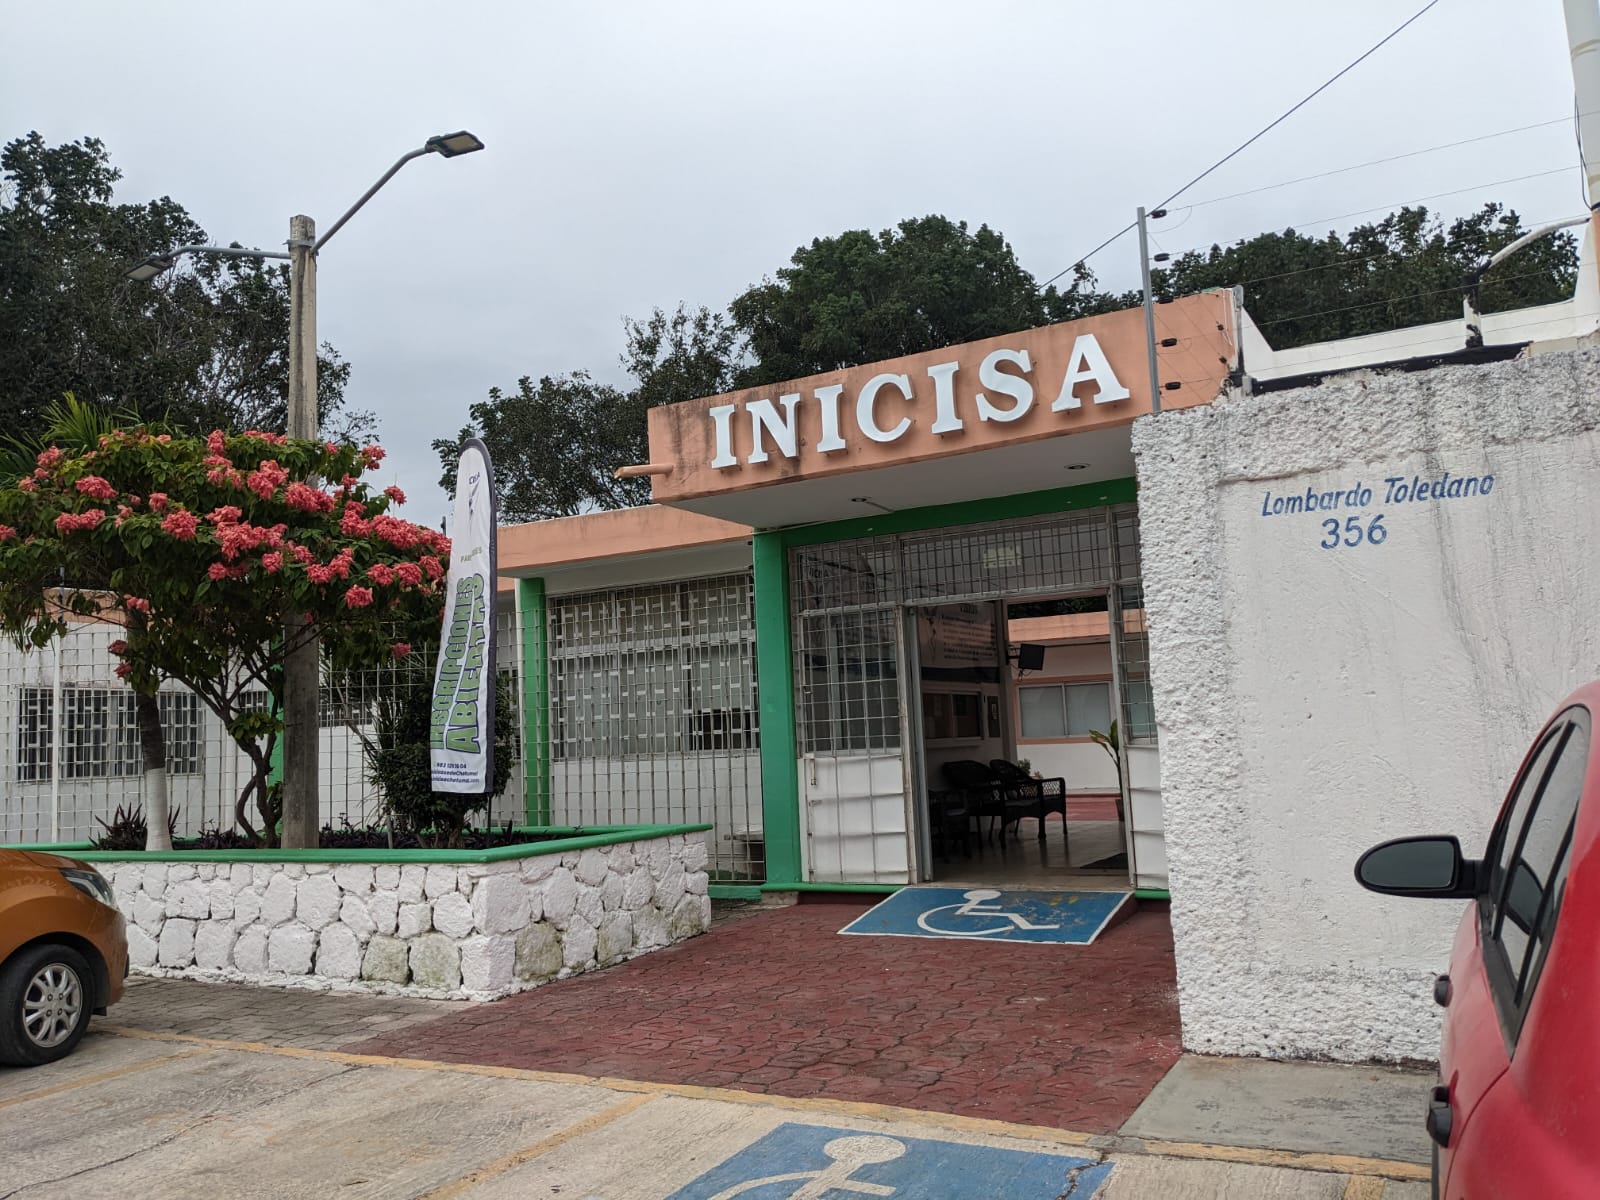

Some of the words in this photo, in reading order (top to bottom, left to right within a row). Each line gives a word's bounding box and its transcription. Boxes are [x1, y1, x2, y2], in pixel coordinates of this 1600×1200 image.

[709, 333, 1130, 470] INICISA
[1262, 482, 1372, 516] Lombardo
[1384, 472, 1494, 504] Toledano
[1321, 514, 1387, 549] 356
[430, 575, 474, 750] INSCRIPCIONES
[446, 573, 485, 754] ABIERTAS
